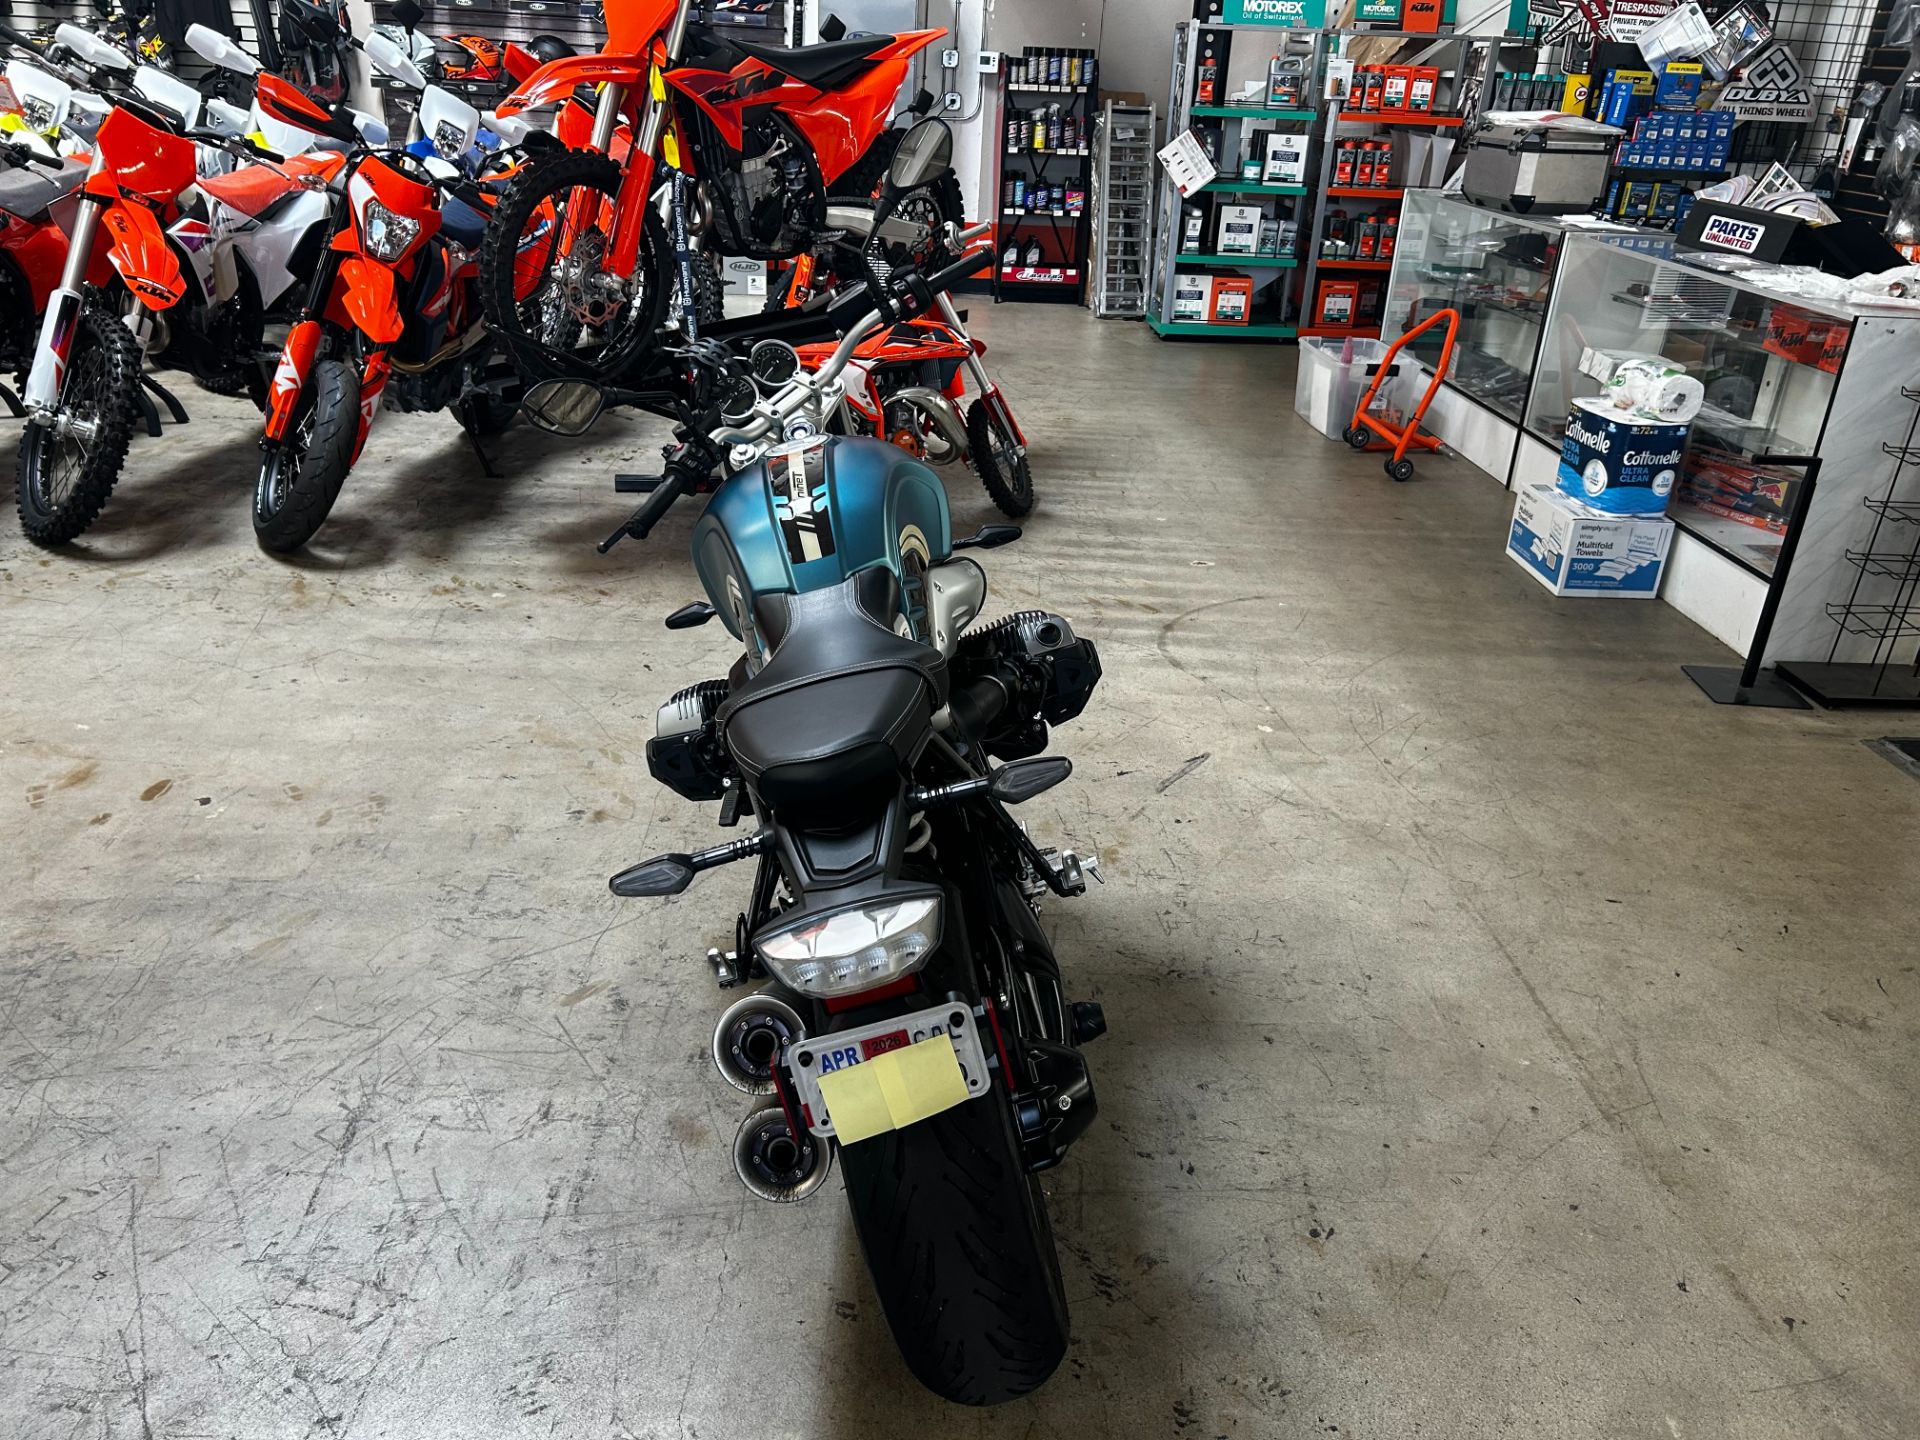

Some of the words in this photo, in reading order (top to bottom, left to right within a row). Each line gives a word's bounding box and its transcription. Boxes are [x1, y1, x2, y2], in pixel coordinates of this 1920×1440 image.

[1243, 0, 1303, 13] MOTOREX
[1363, 4, 1396, 13] MOTOREX
[1410, 3, 1434, 12] KTM
[1616, 1, 1674, 15] TRESPASSING
[1613, 17, 1638, 26] PRIVATE
[1724, 87, 1809, 103] DUBYA
[1739, 107, 1774, 116] THINGS
[1776, 107, 1807, 117] WHEEL
[674, 206, 685, 243] Husqvarna
[1708, 218, 1759, 240] PARTS
[1705, 231, 1753, 250] UNLIMITED
[682, 261, 692, 297] Husqvarna
[136, 284, 173, 304] KTM
[1565, 416, 1611, 454] Cottonelle
[1639, 426, 1651, 435] 72
[1623, 449, 1682, 466] Cottonelle
[1621, 467, 1649, 475] ULTRA
[1619, 475, 1649, 483] CLEAN
[1576, 541, 1614, 550] Multifold
[1576, 548, 1604, 557] Towels
[1571, 562, 1595, 571] 3000
[872, 1037, 900, 1050] 2026
[821, 1045, 861, 1074] APR
